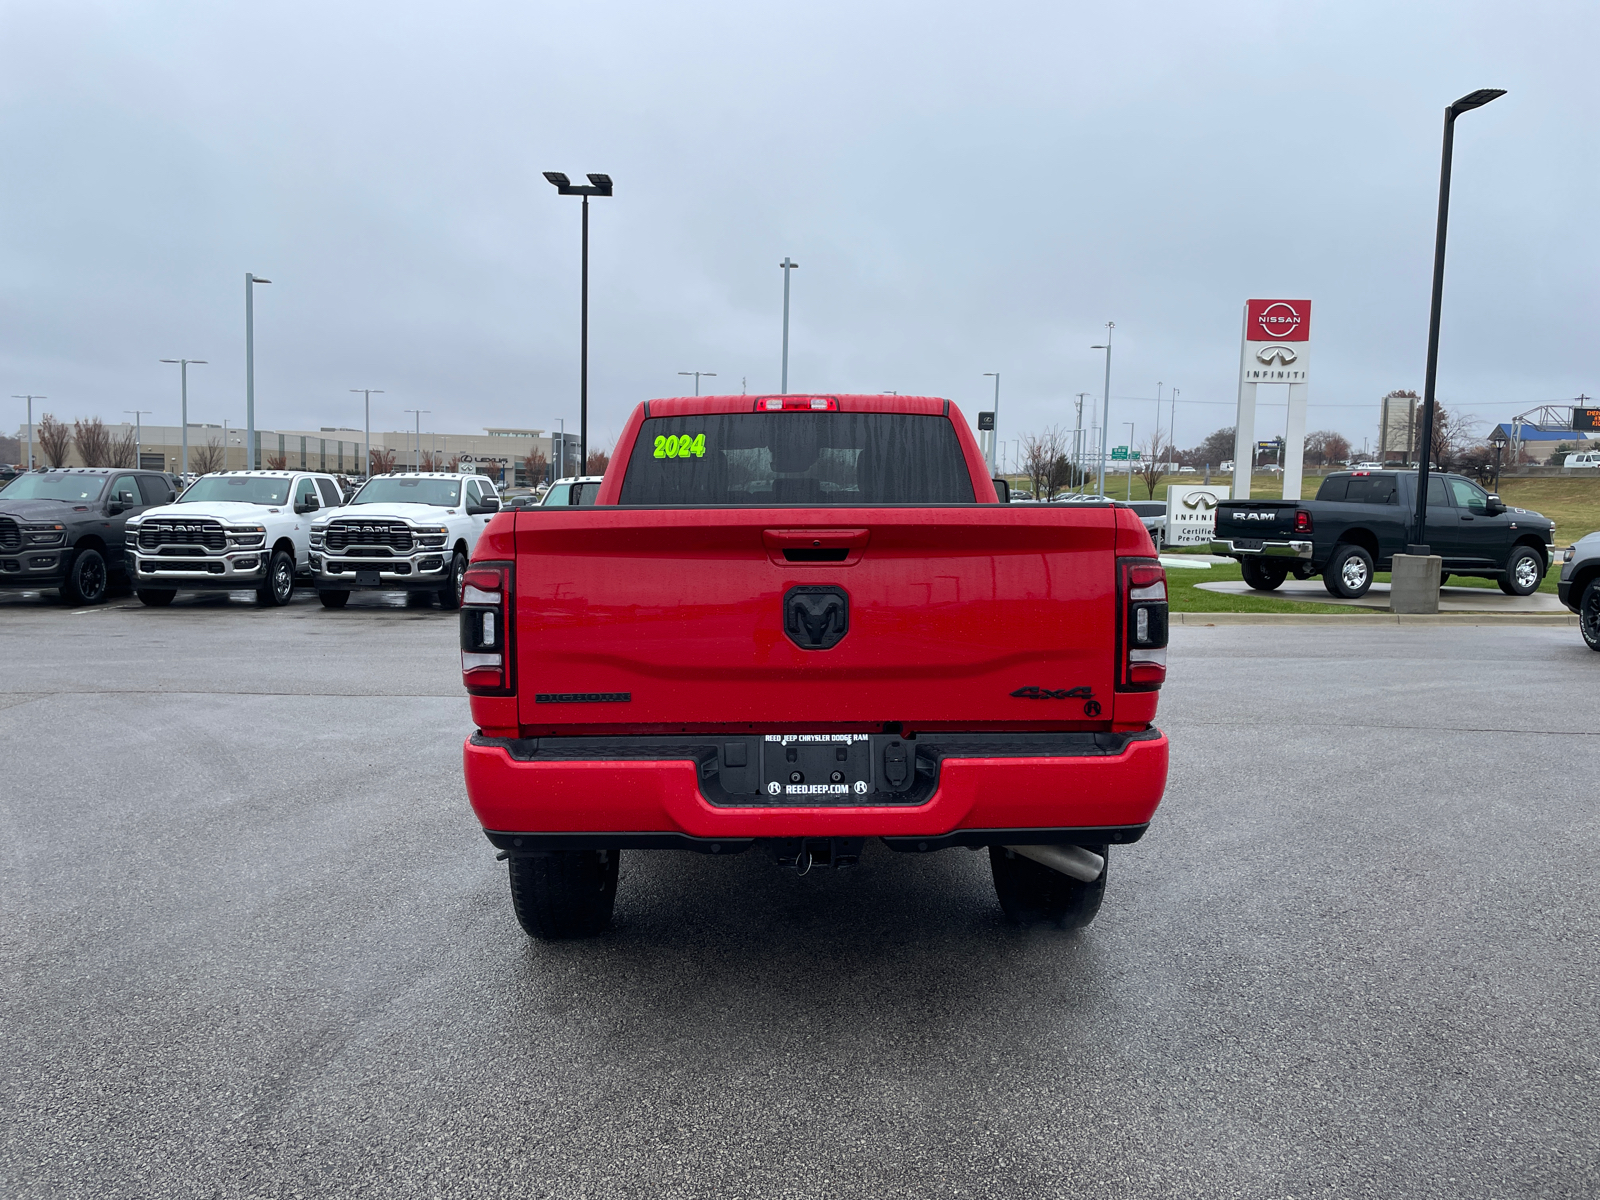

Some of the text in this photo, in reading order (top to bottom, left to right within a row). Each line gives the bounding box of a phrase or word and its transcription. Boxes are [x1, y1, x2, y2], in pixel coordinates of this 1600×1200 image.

[1246, 370, 1305, 379] INFINITI
[653, 433, 706, 458] 2024
[1175, 513, 1213, 521] INFINI
[1232, 512, 1275, 520] RAM
[159, 524, 202, 532] RAM
[347, 525, 389, 533] RAM
[765, 734, 781, 742] REED
[783, 734, 798, 742] JEEP
[798, 734, 831, 742] CHRYSLER
[831, 734, 852, 742] DODGE
[785, 784, 849, 794] REEDJEEP.COM
